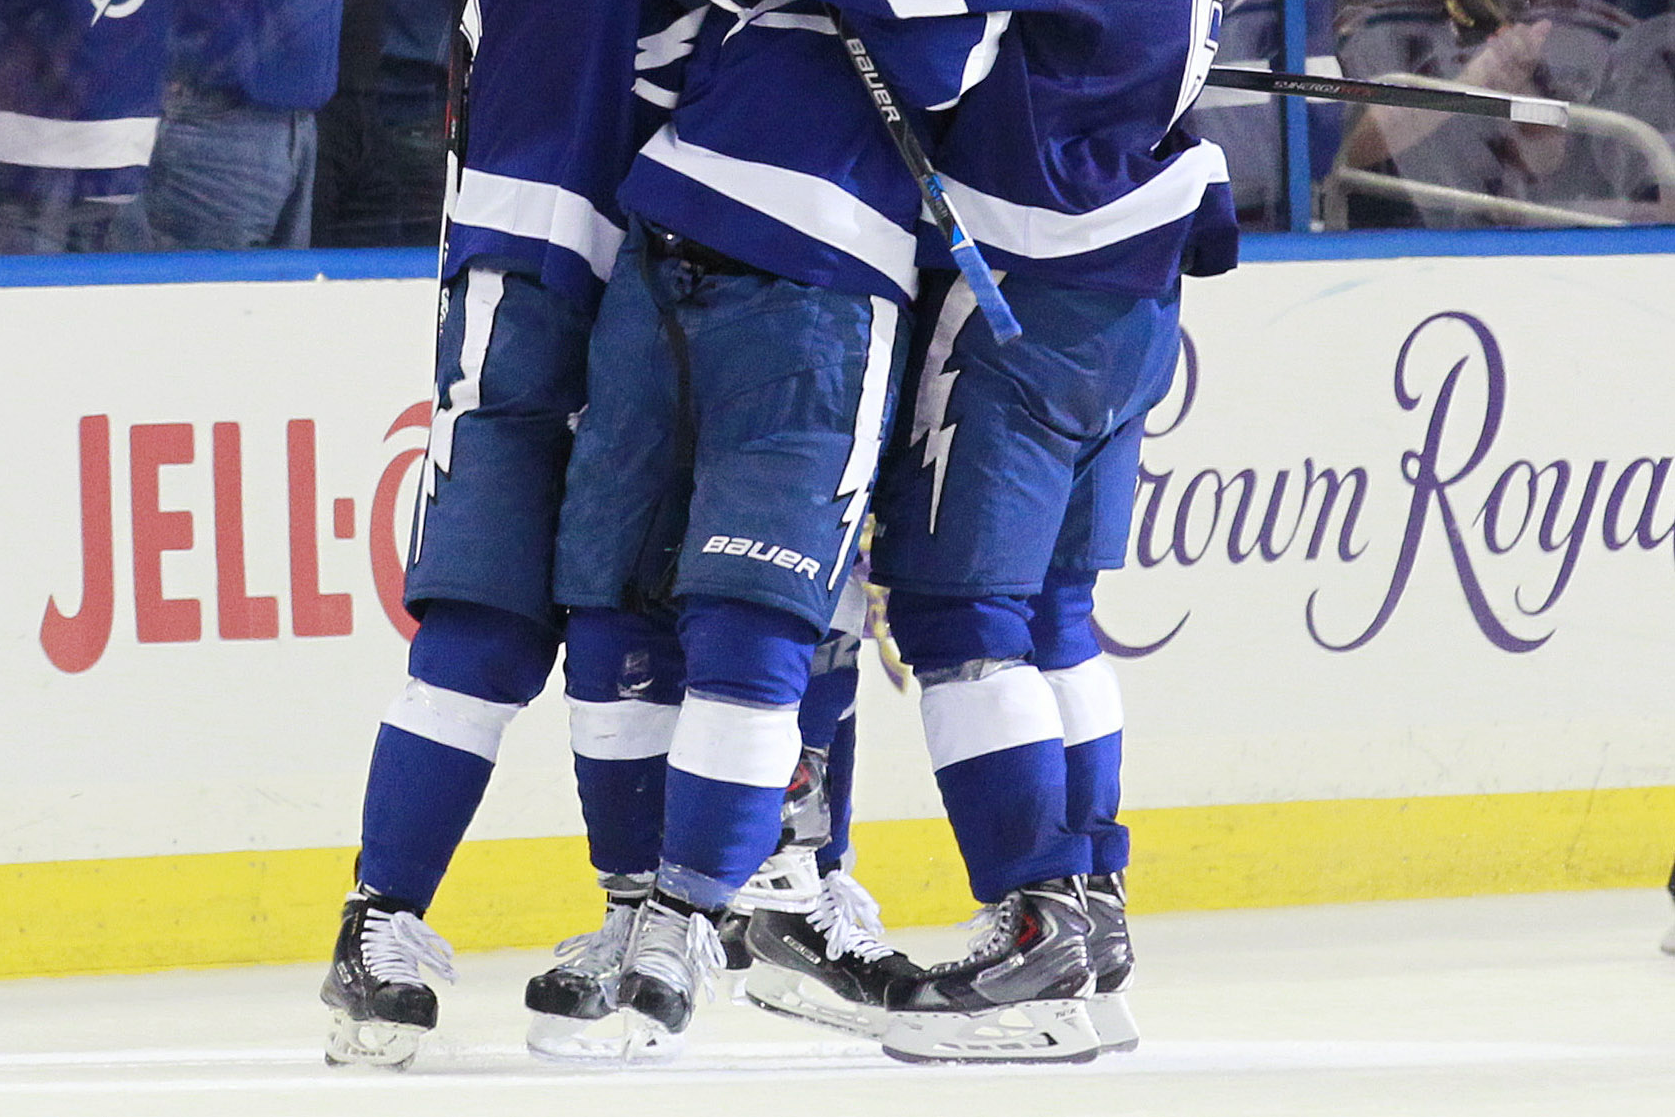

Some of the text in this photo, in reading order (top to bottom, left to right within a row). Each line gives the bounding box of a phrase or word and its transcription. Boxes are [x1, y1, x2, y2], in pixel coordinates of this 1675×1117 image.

[845, 37, 901, 124] BAUER
[1306, 310, 1675, 654] Roya
[701, 535, 821, 581] BAUER
